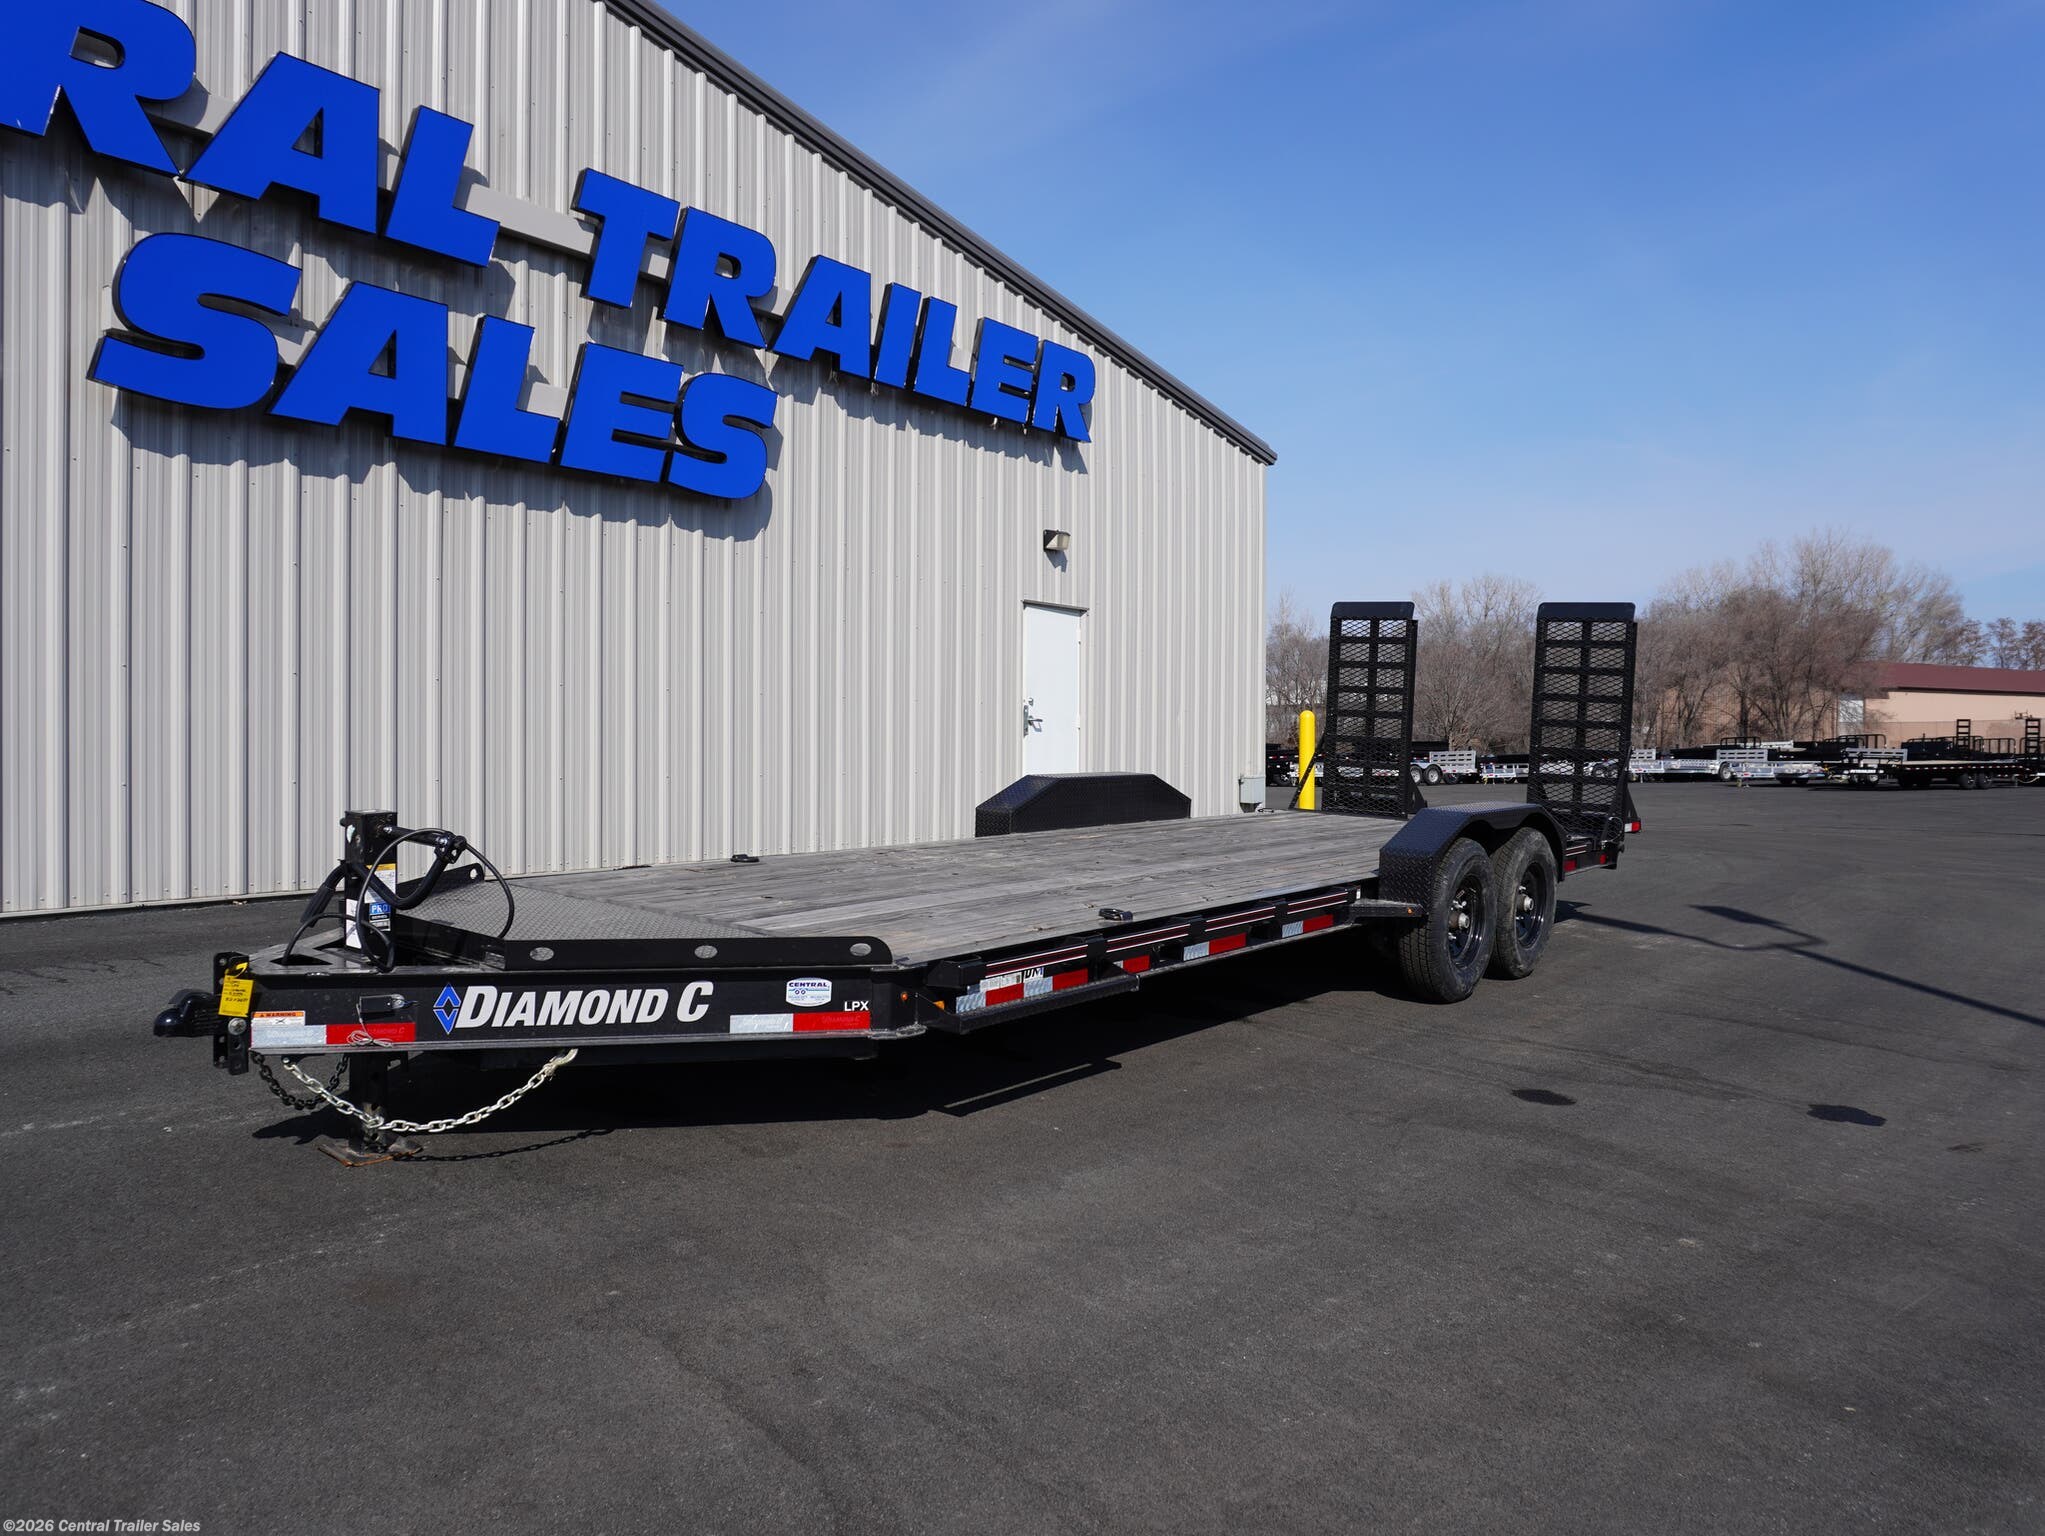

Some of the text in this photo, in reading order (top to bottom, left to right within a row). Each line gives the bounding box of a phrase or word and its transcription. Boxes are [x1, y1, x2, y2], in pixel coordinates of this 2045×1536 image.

[571, 167, 1096, 443] TRAILER
[87, 232, 778, 500] SALES
[371, 904, 388, 914] PRO
[454, 981, 714, 1029] DIAMOND C
[844, 1000, 869, 1012] LPX
